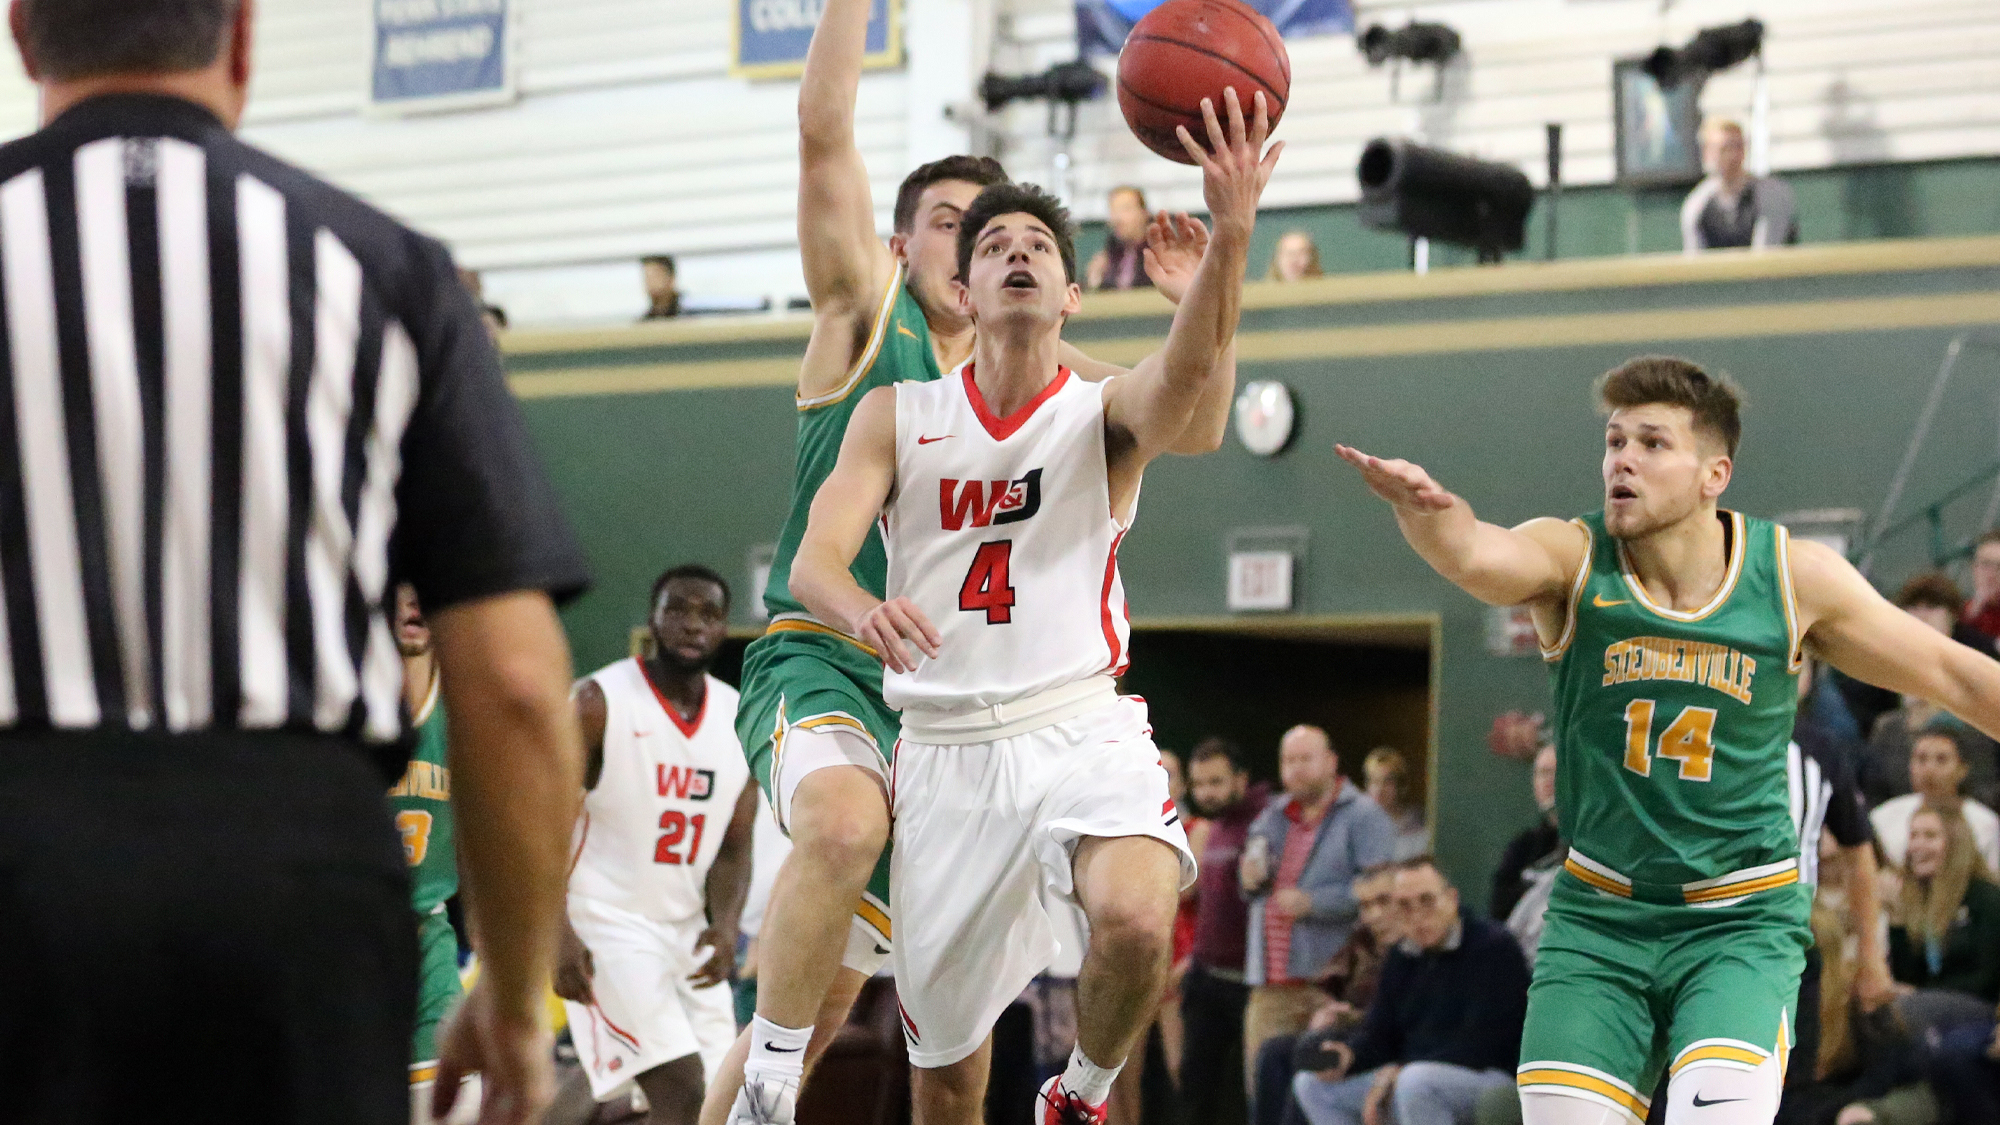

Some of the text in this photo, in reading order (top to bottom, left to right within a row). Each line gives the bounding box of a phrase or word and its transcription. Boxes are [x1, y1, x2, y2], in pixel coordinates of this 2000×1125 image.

[958, 539, 1015, 625] 4
[1602, 636, 1757, 705] STEUBENVILLE
[1623, 698, 1718, 782] 14
[654, 809, 706, 865] 21
